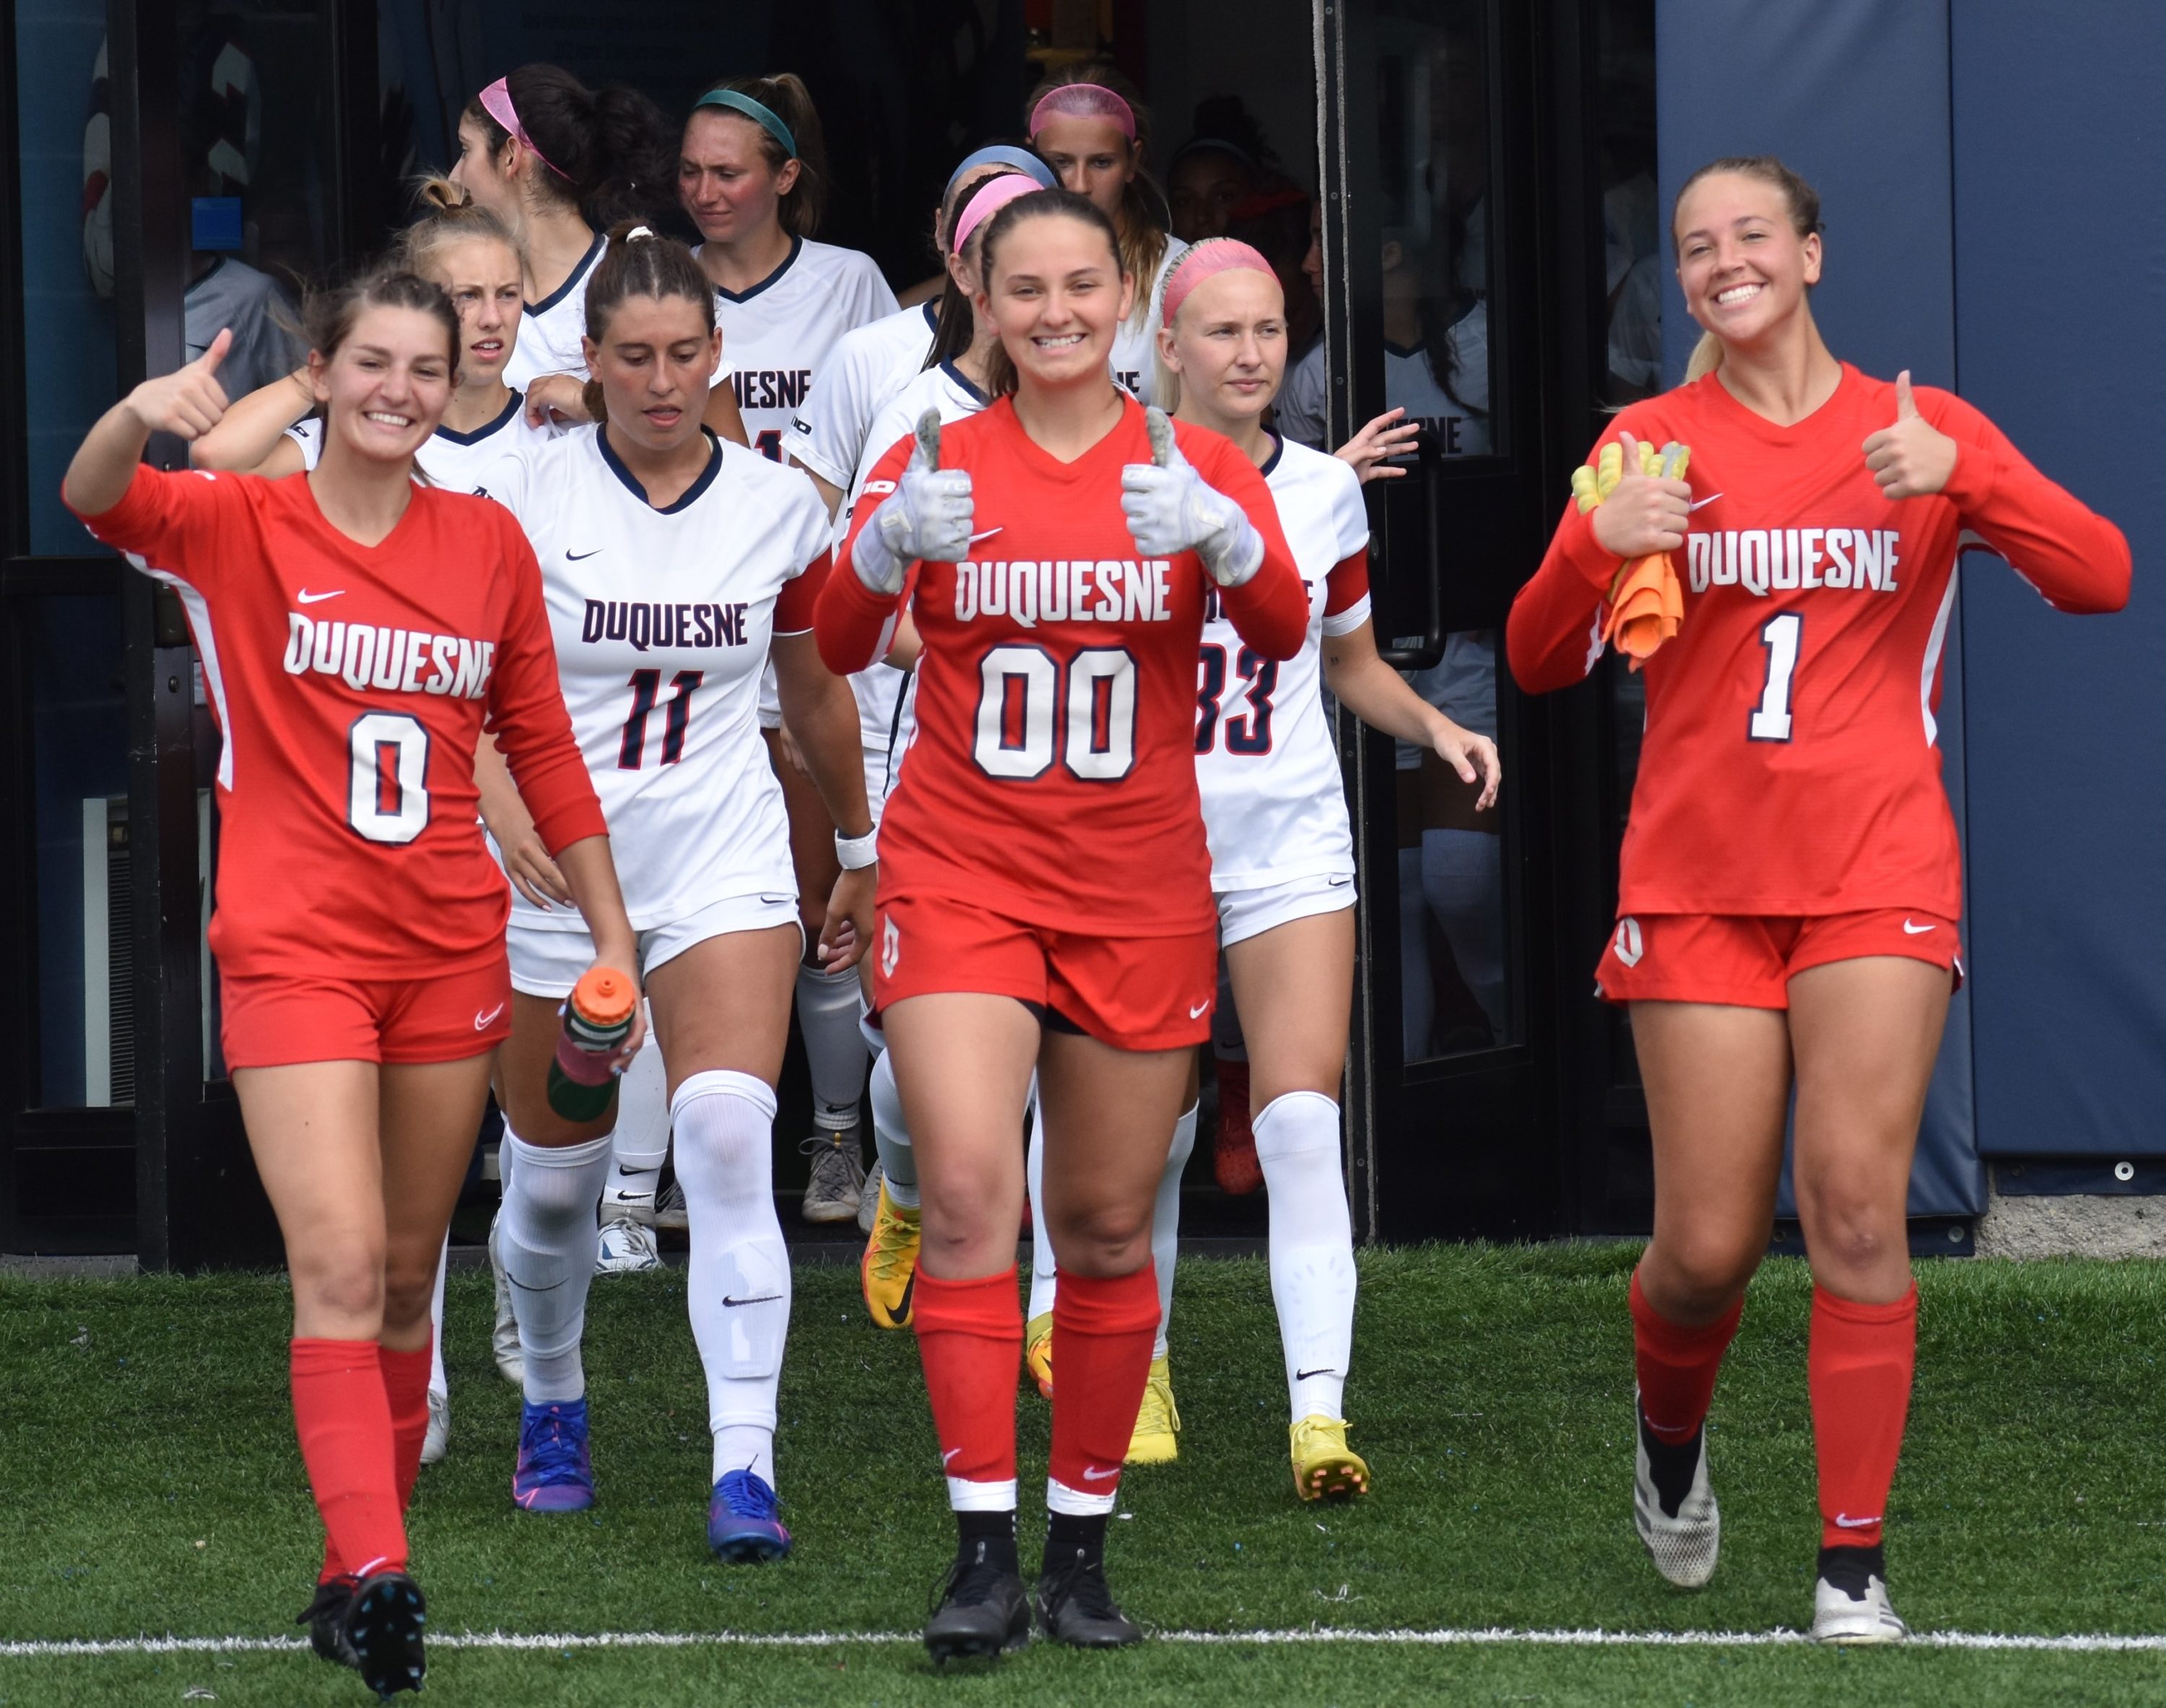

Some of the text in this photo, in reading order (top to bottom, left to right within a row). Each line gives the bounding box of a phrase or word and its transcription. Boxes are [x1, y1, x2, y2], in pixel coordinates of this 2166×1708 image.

[954, 560, 1171, 628] DUQUESNE
[1688, 528, 1900, 596] DUQUESNE
[283, 612, 495, 700] DUQUESNE
[581, 598, 749, 651] DUQUESNE
[618, 668, 705, 770] 11
[971, 642, 1139, 783] 00
[1747, 610, 1804, 743] 1
[347, 710, 431, 846] 0
